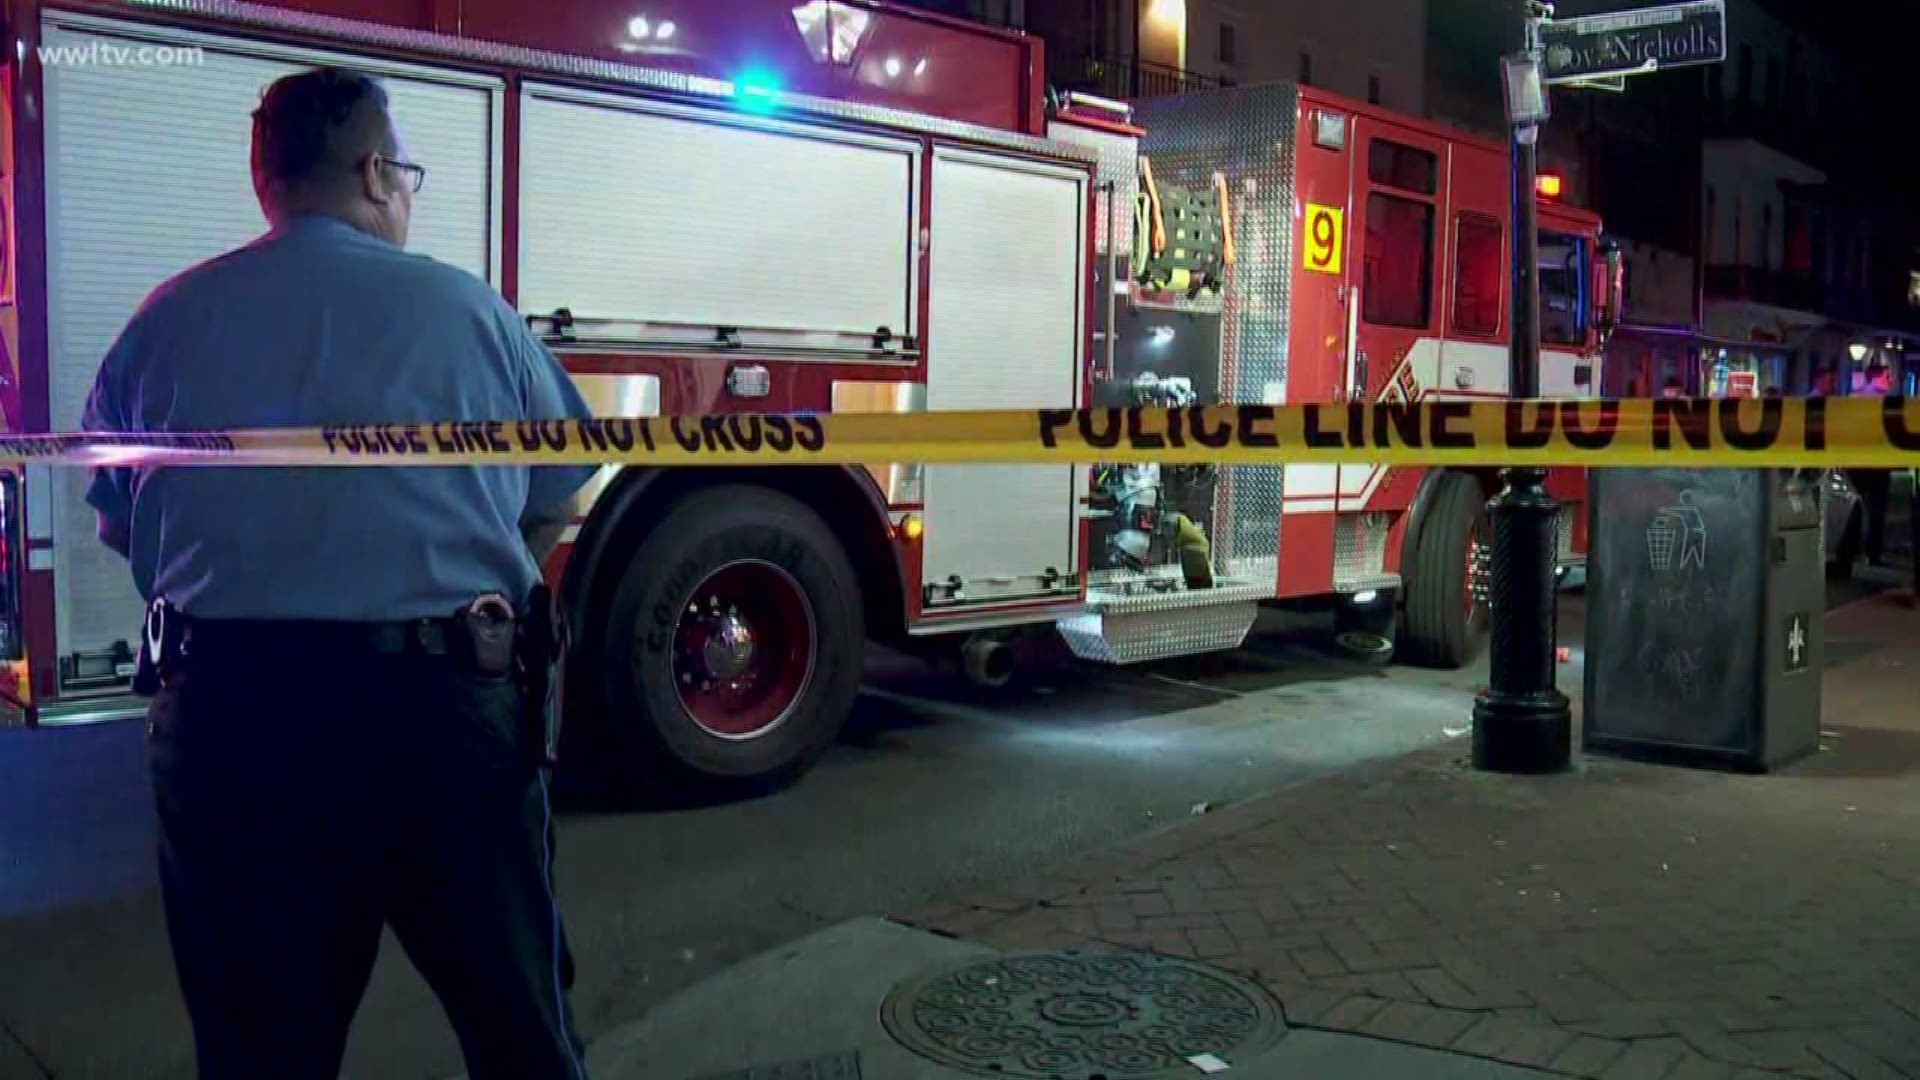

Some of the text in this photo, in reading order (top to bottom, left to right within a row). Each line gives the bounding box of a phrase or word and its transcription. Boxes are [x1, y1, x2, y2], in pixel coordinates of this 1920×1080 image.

[1614, 23, 1718, 62] Nicholls
[1312, 210, 1335, 267] 9
[322, 415, 827, 456] POLICE LINE DO NOT CROSS
[1038, 404, 1281, 449] POLICE
[1303, 402, 1476, 449] LINE
[1504, 400, 1619, 450] DO
[1651, 399, 1828, 451] NOT
